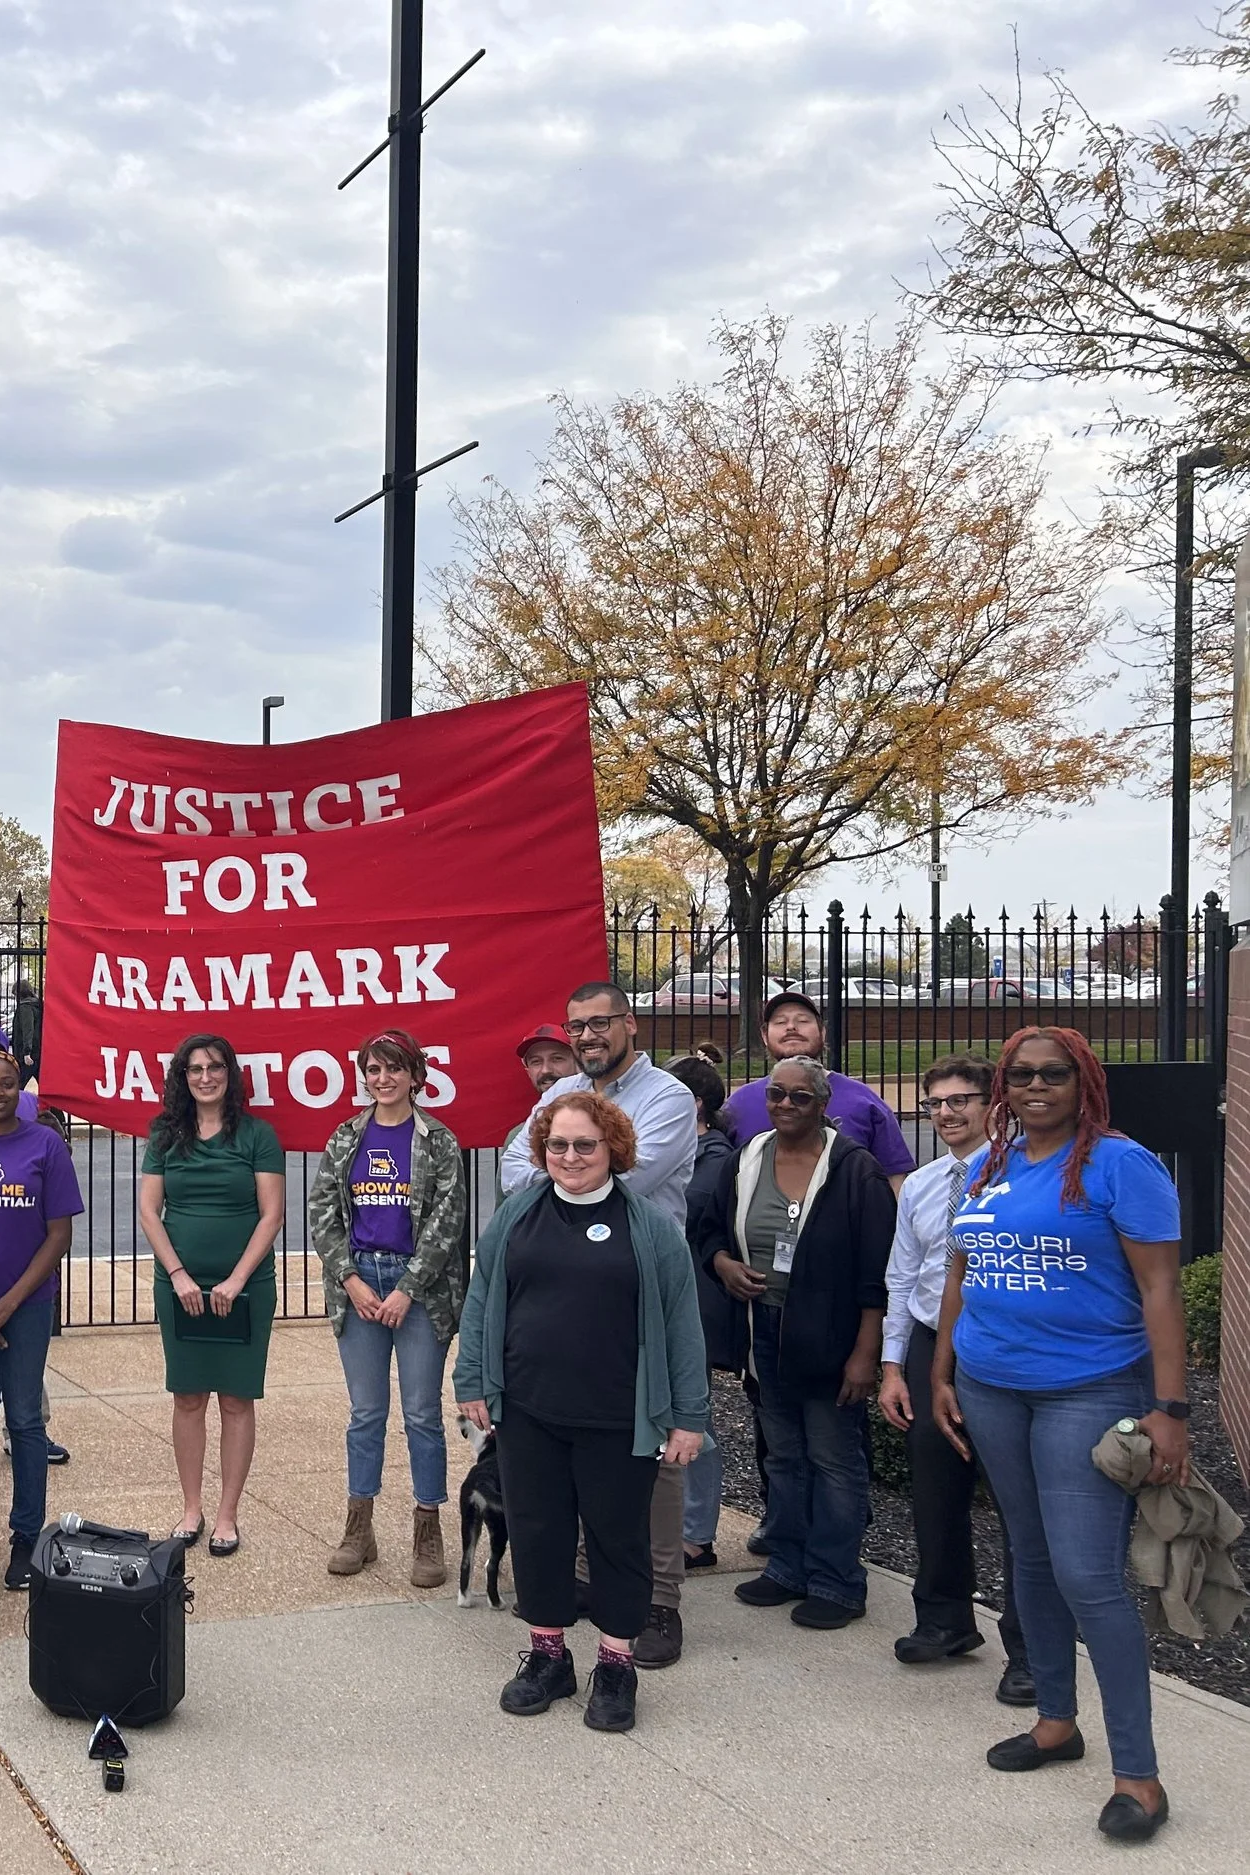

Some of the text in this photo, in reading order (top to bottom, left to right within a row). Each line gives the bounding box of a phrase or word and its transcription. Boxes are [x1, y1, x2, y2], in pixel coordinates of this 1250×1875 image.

[94, 773, 405, 838] JUSTICE
[162, 852, 317, 915] FOR
[88, 943, 456, 1011] ARAMARK
[95, 1045, 456, 1110] JATOS
[2, 1184, 25, 1196] ME
[352, 1182, 392, 1195] SHOW
[967, 1252, 1087, 1271] ORKERS
[964, 1270, 1047, 1291] ENTER
[81, 1583, 103, 1592] ION
